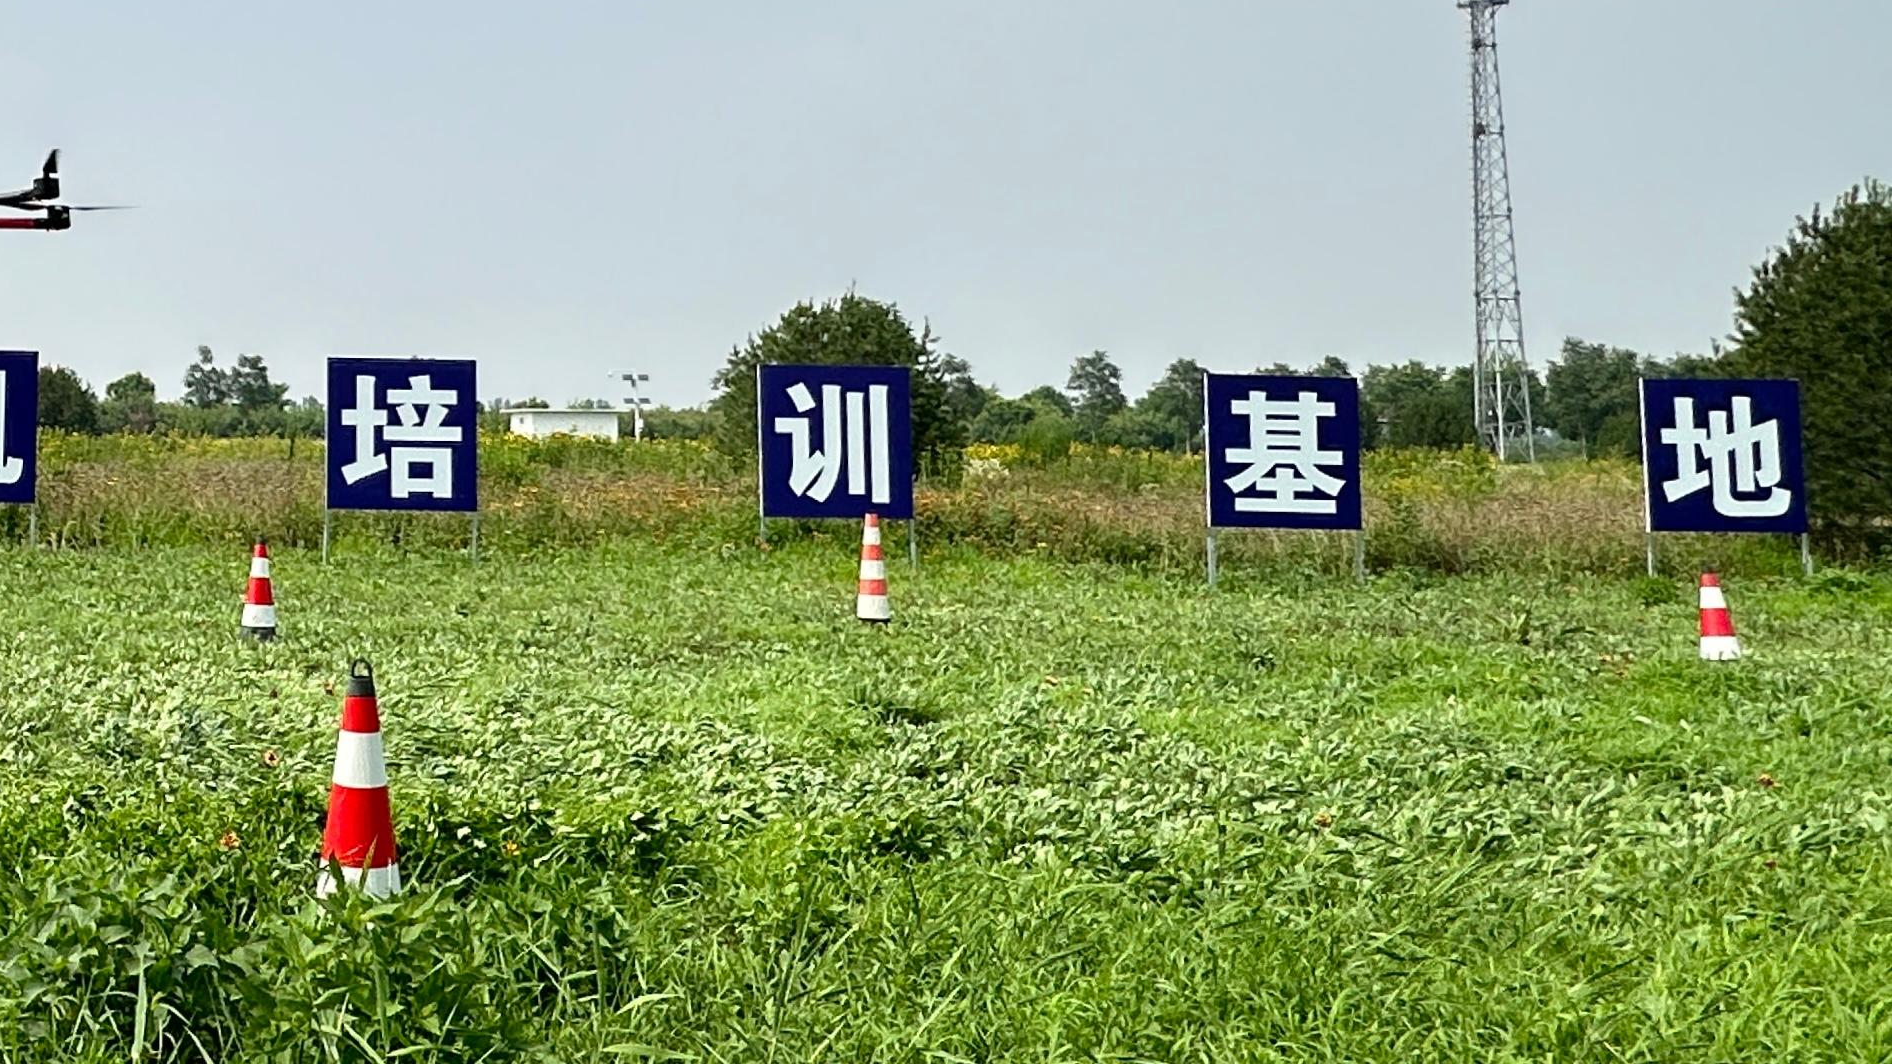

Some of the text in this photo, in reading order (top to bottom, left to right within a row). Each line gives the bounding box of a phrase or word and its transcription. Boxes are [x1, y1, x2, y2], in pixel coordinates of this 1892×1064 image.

[340, 374, 463, 499] 培
[774, 382, 891, 505] 训
[1223, 390, 1347, 515] 基
[1659, 396, 1792, 518] 地
